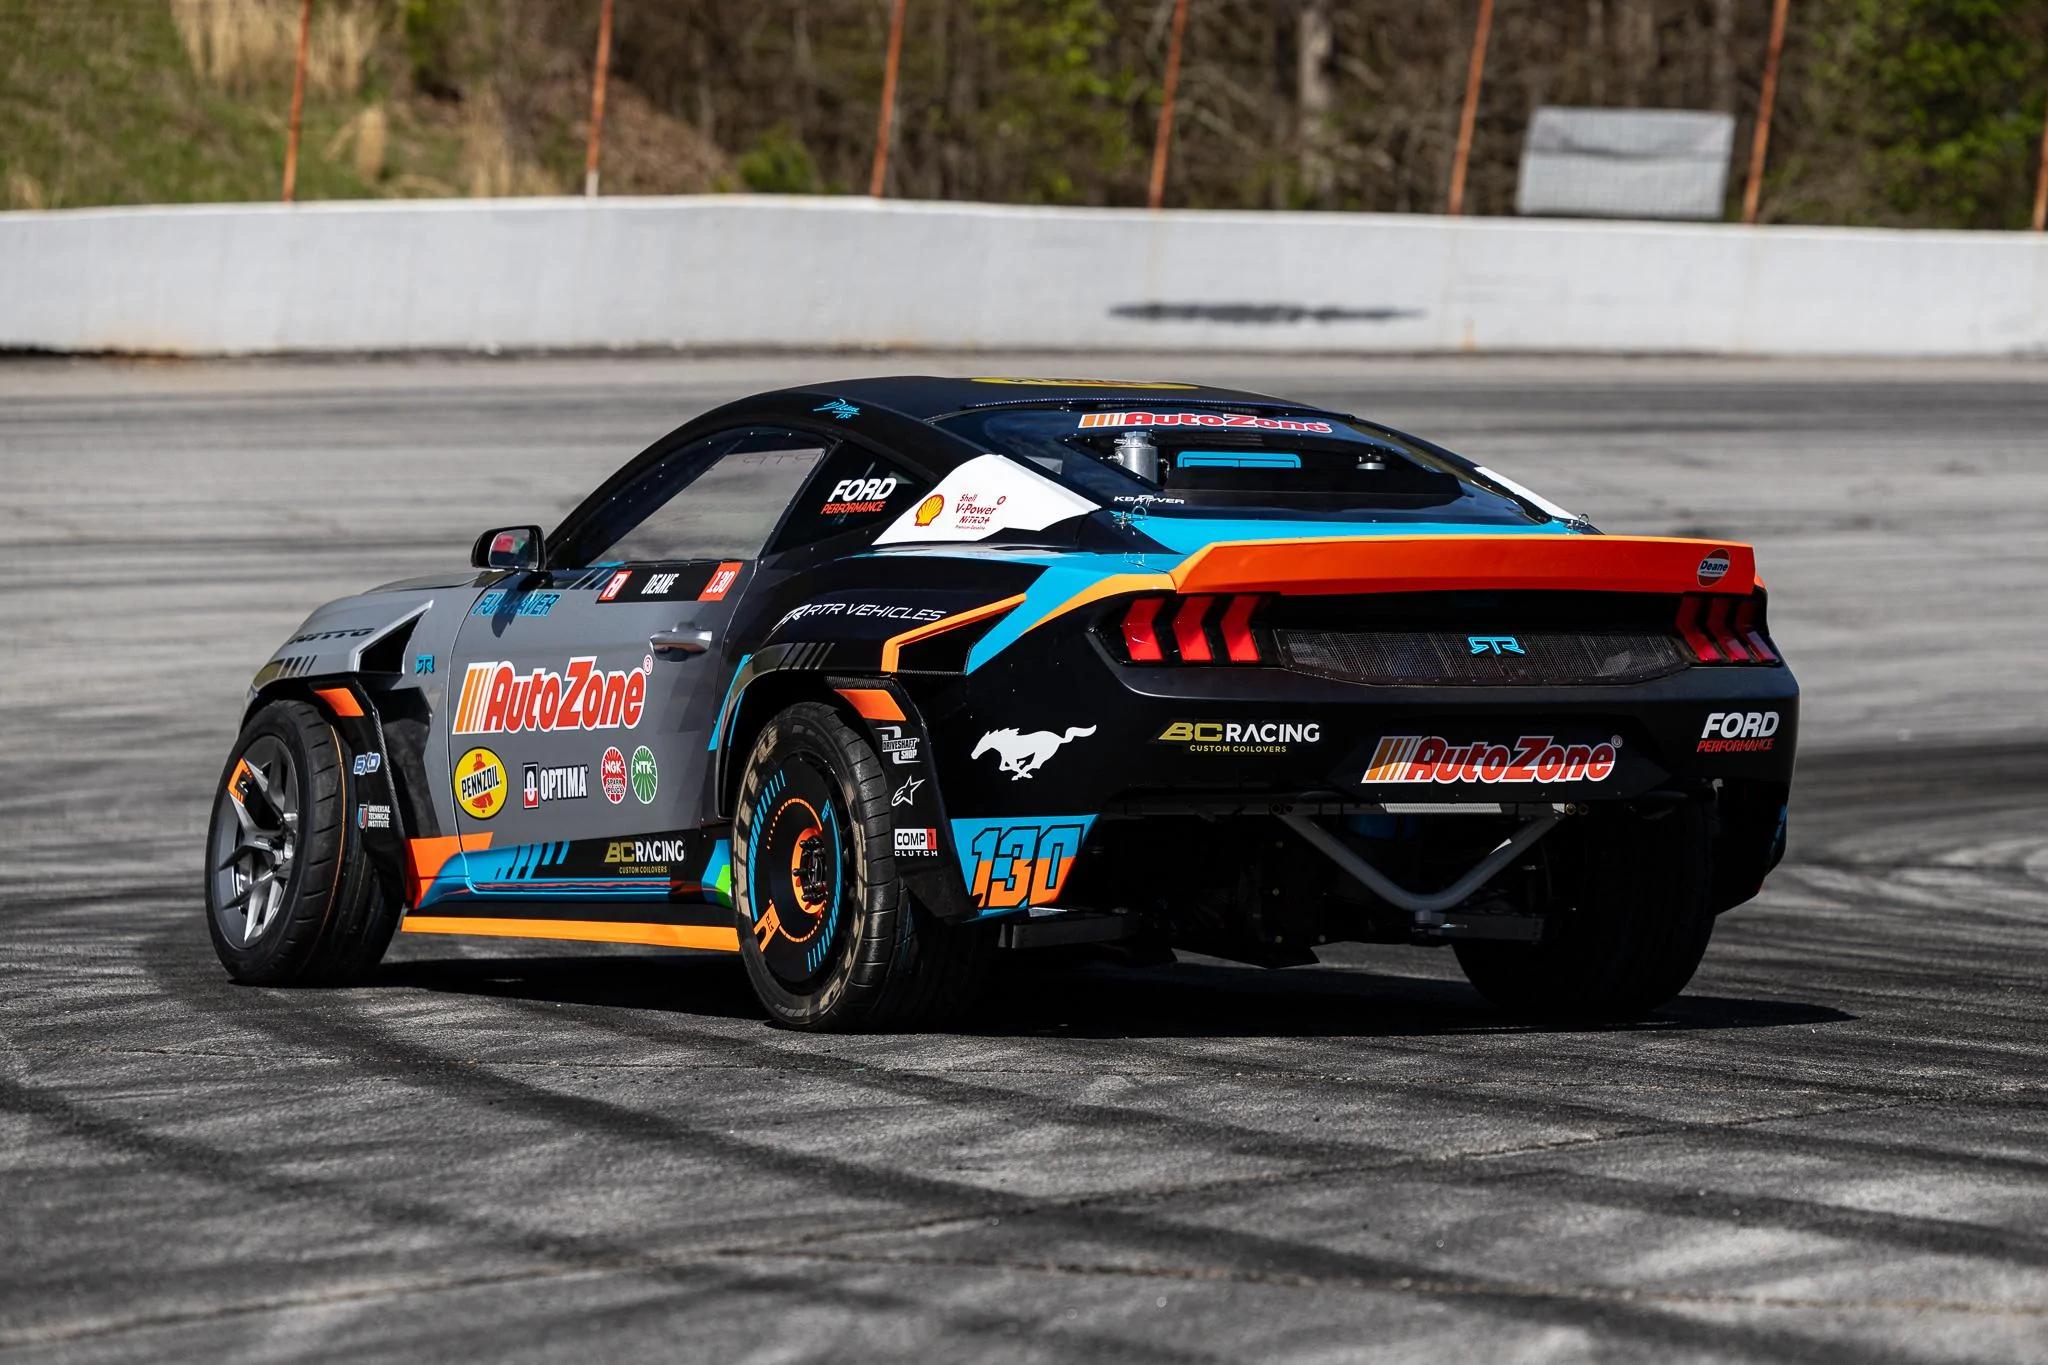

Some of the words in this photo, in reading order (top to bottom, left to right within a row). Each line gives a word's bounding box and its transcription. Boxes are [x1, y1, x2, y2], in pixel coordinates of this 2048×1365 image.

[1122, 412, 1333, 433] AutoZone
[827, 477, 897, 502] FORD
[960, 493, 978, 502] Shell
[820, 501, 886, 514] PERFORMANCE
[955, 502, 997, 515] V-Power
[1700, 560, 1728, 571] Deane
[640, 573, 679, 595] DEANE
[705, 570, 735, 594] 130
[803, 603, 846, 617] RTR
[846, 603, 947, 621] VEHICLES
[482, 655, 647, 734] AutoZone
[1701, 711, 1780, 738] FORD
[882, 738, 917, 751] DRIVESHAFT
[1189, 744, 1231, 752] CUSTOM
[1232, 745, 1287, 753] COILOVERS
[1696, 738, 1774, 752] PERFORMANCE
[900, 749, 918, 760] SHOP
[1405, 736, 1617, 784] AutoZone
[605, 760, 622, 774] NGK
[635, 760, 653, 774] NTK
[461, 765, 500, 801] PENNZOIL
[540, 766, 588, 801] OPTIMA
[606, 777, 622, 785] SPARK
[606, 786, 623, 794] PLUGS
[368, 805, 391, 813] UNIVERSAL
[367, 820, 390, 828] INSTITUTE
[619, 866, 639, 874] CUSTOM
[640, 865, 668, 874] COILOVERS
[971, 824, 1085, 909] 130
